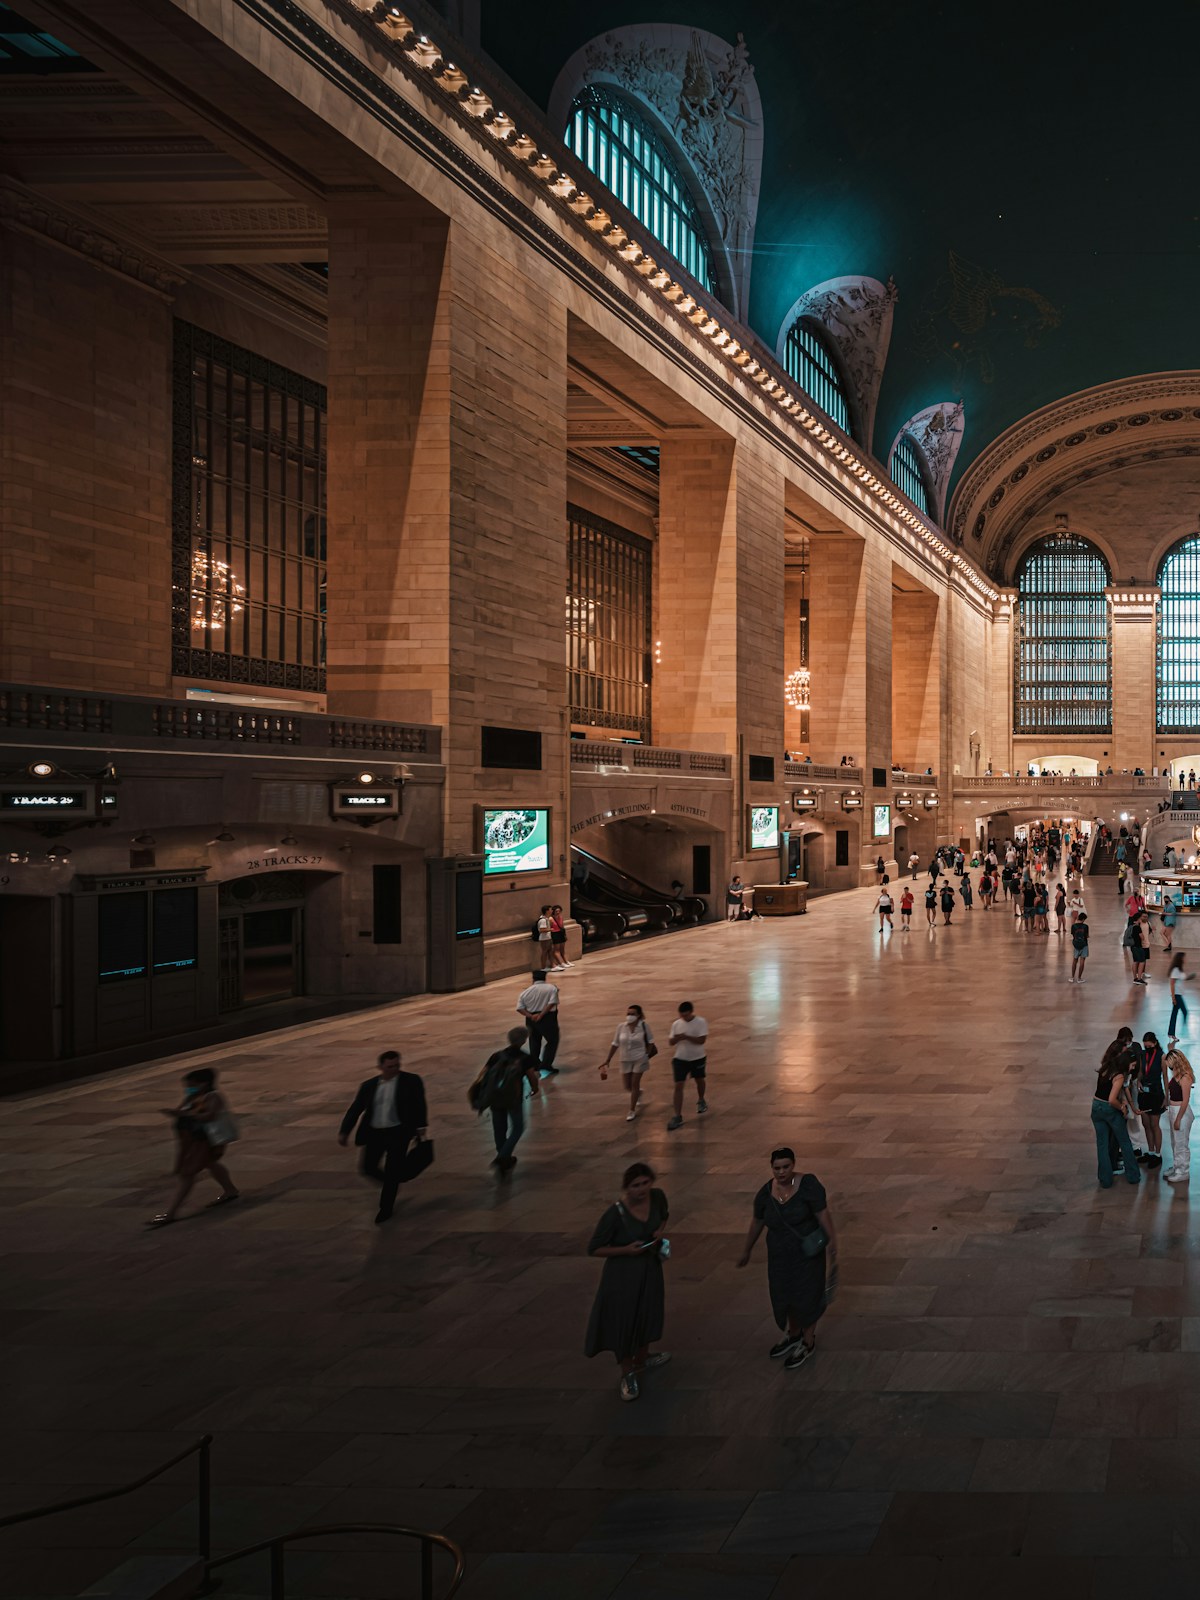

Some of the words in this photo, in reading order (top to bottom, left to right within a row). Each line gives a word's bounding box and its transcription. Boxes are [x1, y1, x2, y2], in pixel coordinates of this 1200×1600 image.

[12, 796, 58, 804] TRACK
[60, 796, 74, 804] 29
[617, 803, 650, 815] BUILDING
[686, 806, 707, 818] STREET
[247, 860, 259, 870] 28
[262, 855, 308, 867] TRACKS
[310, 856, 322, 865] 27
